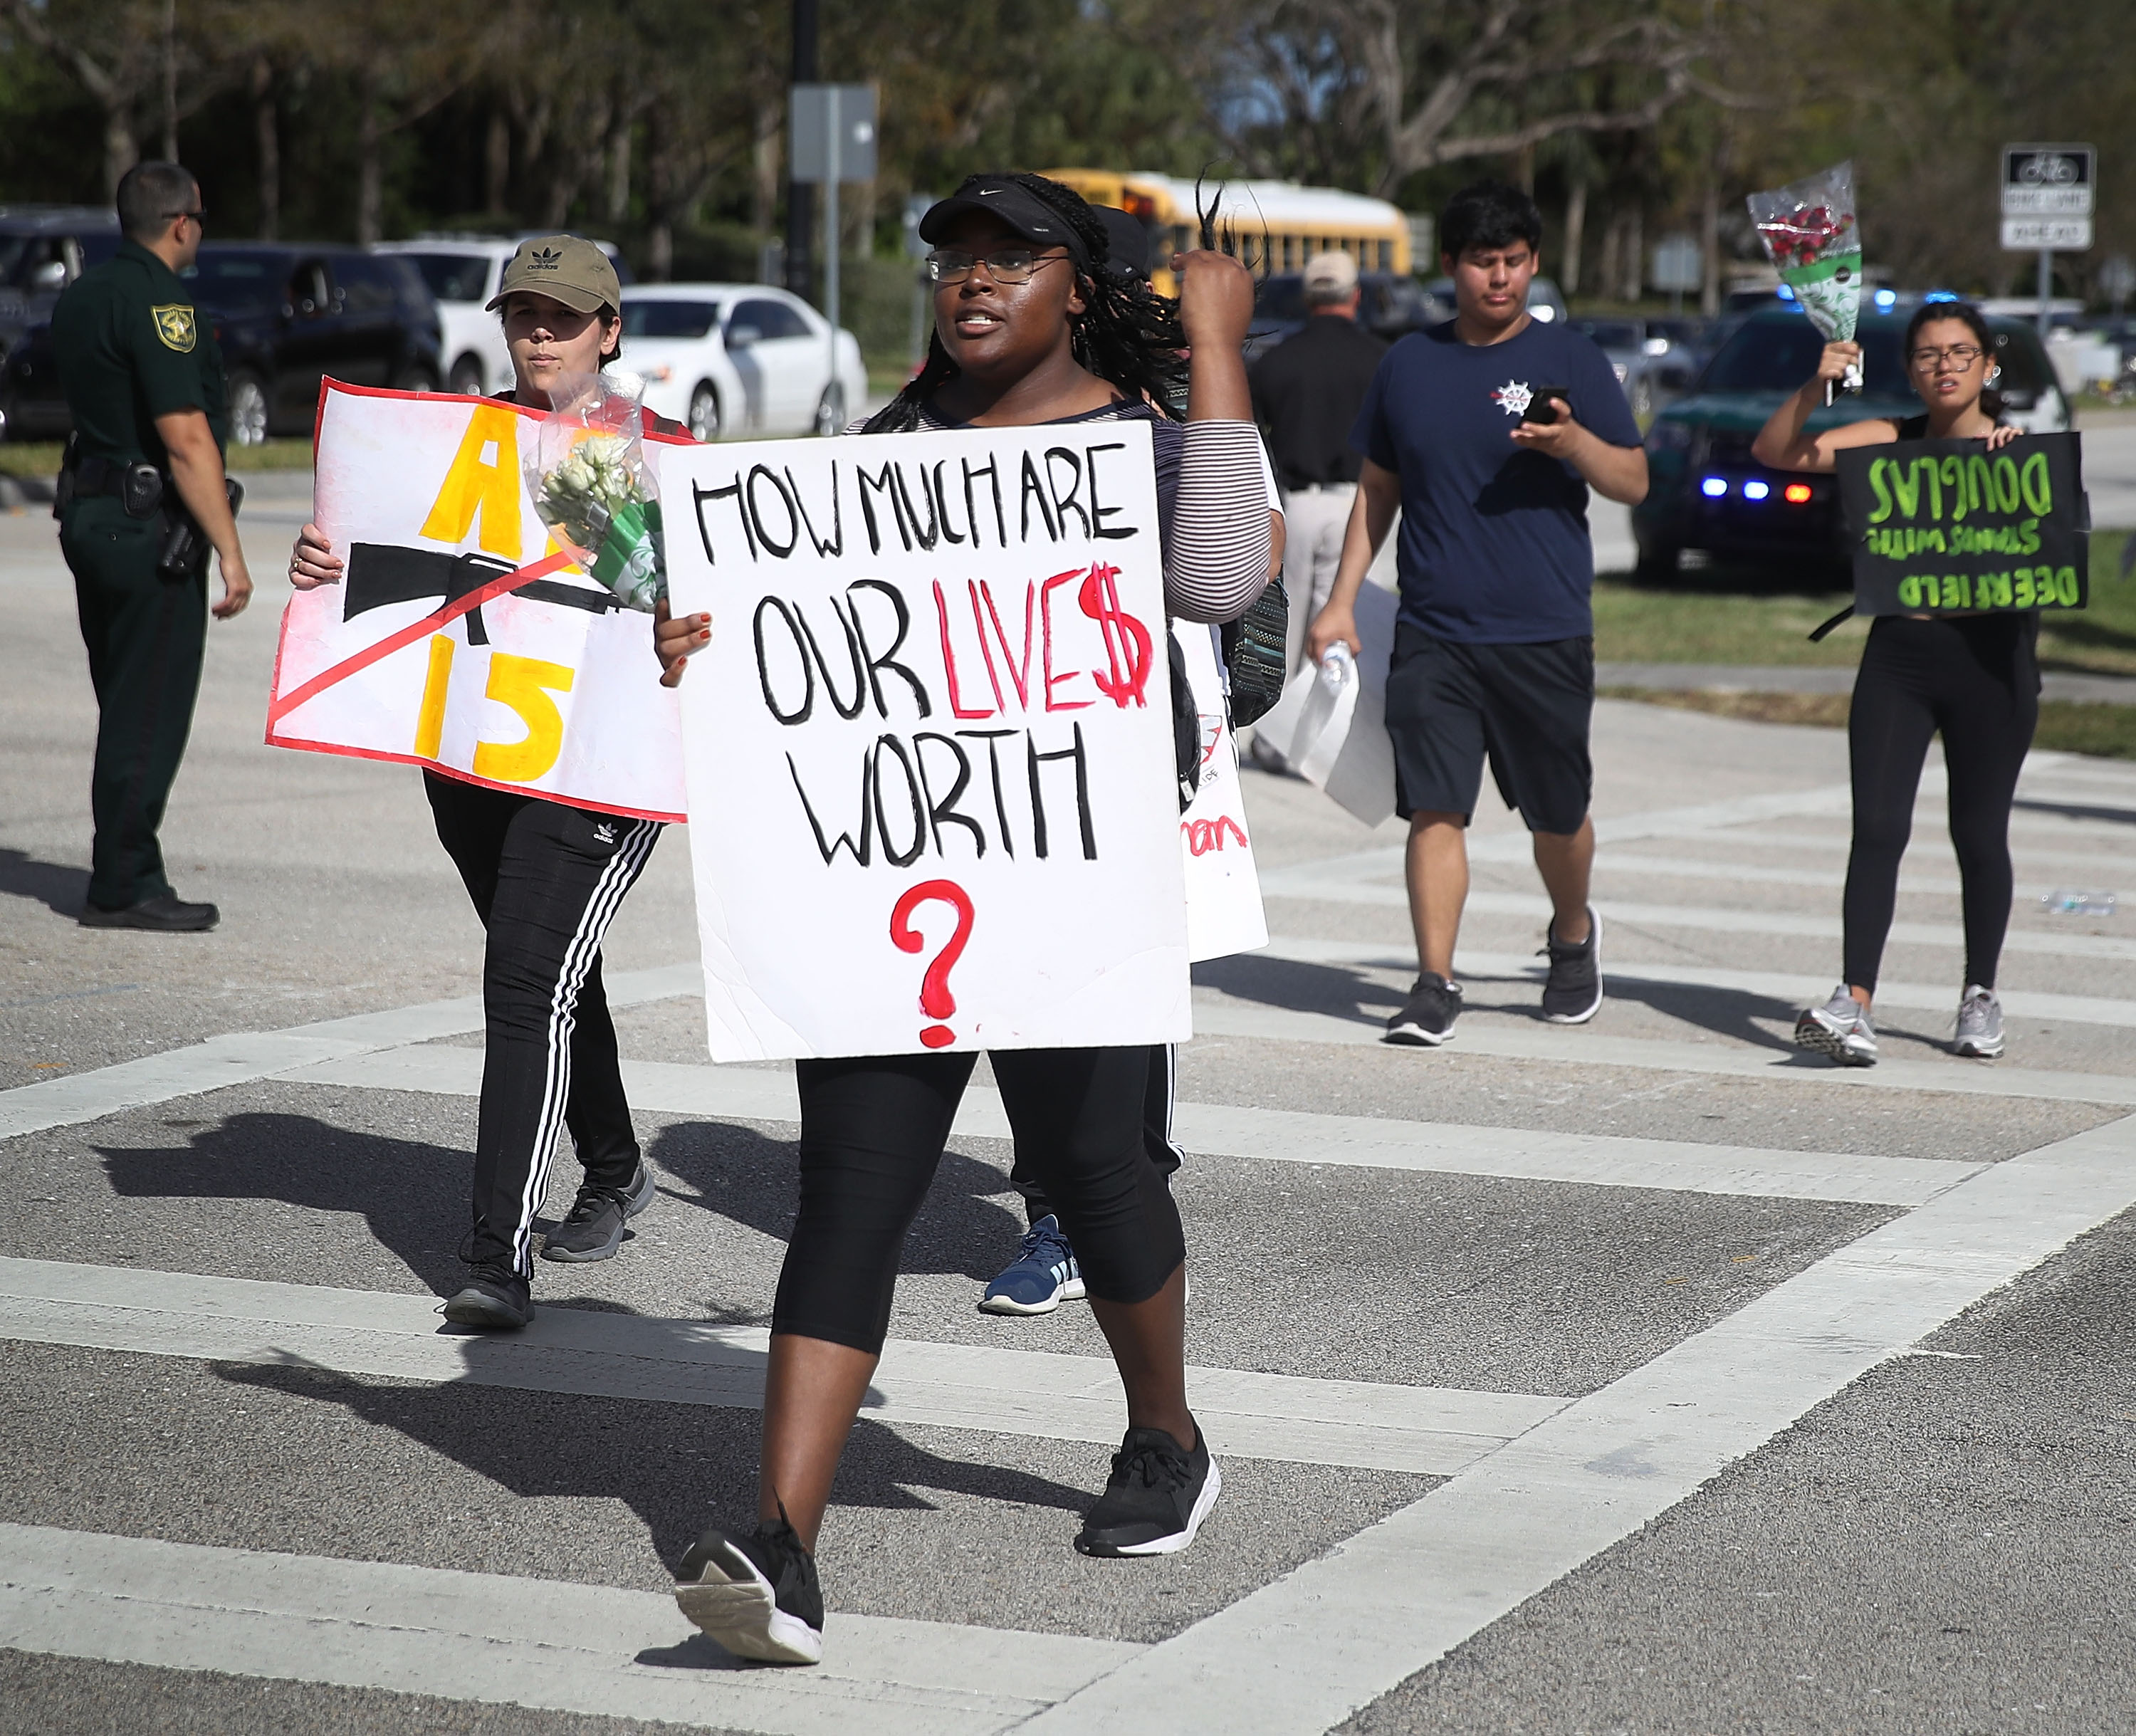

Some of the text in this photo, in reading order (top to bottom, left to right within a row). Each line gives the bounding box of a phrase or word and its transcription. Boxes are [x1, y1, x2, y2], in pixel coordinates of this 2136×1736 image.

[692, 442, 1140, 565] HOW MUCH ARE
[1867, 518, 2042, 560] STANDS WITH
[1868, 452, 2053, 523] DOUGLAS
[753, 561, 1154, 726] OUR LIVE$
[1899, 565, 2079, 609] DEERFIELD
[414, 634, 575, 783] 15
[785, 721, 1098, 868] WORTH
[889, 878, 975, 1049] ?
